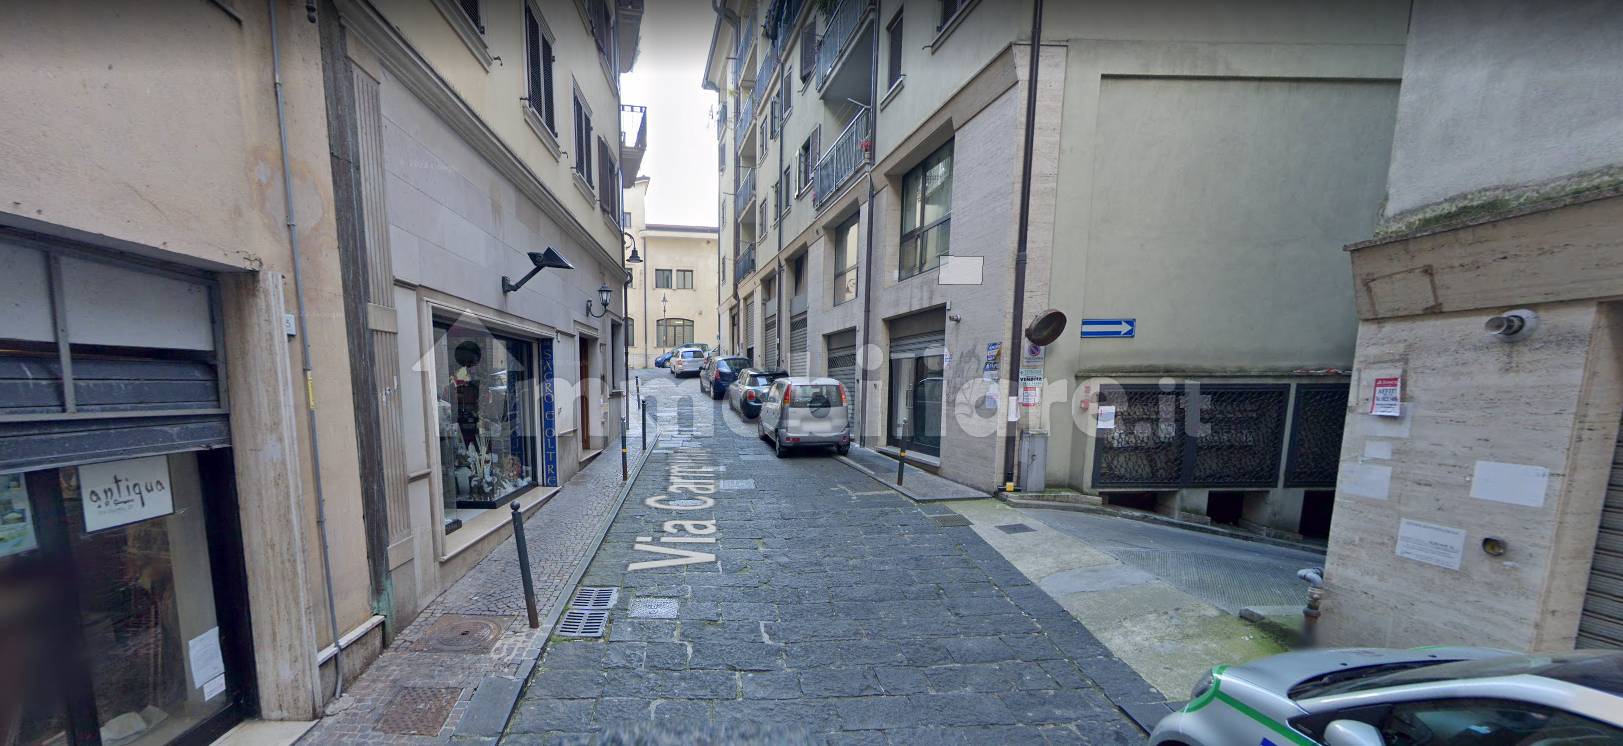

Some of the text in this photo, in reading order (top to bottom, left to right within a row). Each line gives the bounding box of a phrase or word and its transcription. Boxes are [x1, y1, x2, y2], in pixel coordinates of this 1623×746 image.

[543, 348, 554, 403] SACRO
[544, 430, 557, 486] OLTRE
[89, 474, 165, 508] antiqua
